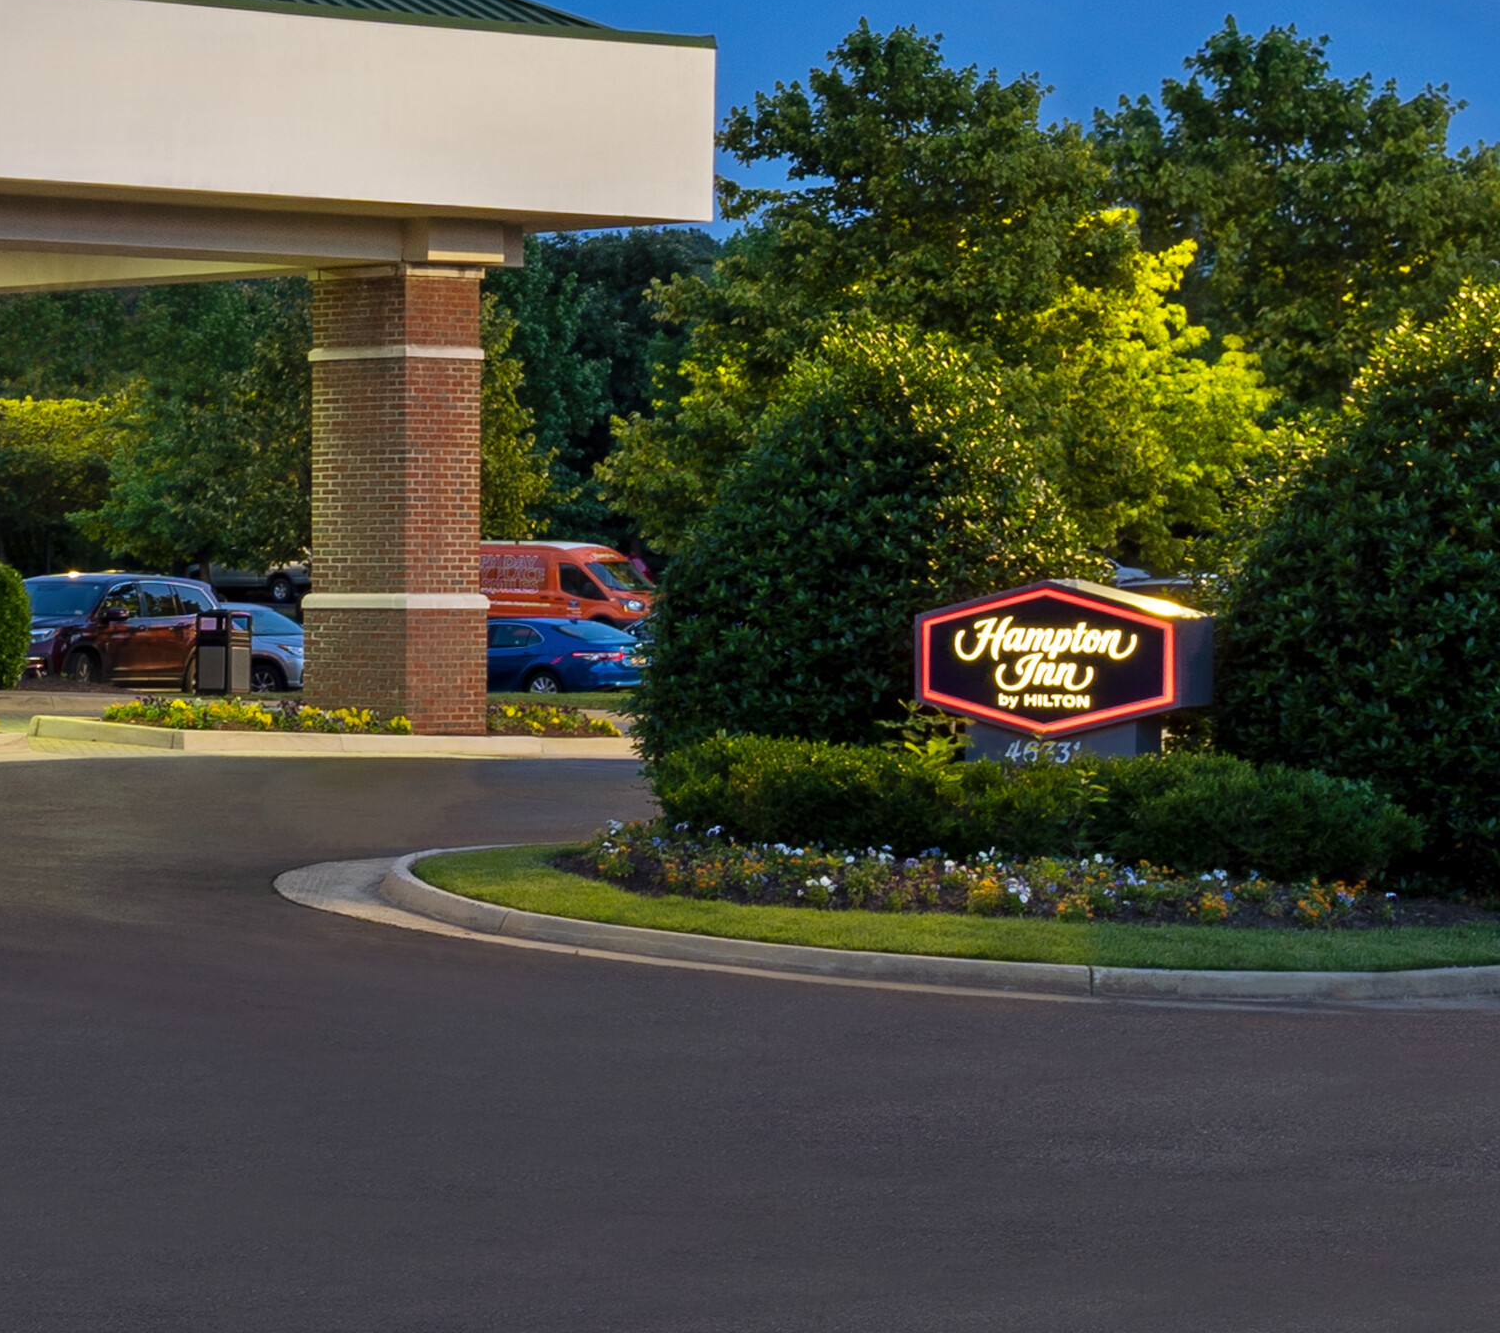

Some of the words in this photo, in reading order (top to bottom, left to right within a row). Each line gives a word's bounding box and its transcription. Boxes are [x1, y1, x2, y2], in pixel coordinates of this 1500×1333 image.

[954, 615, 1138, 661] Hampton
[995, 652, 1094, 691] Inn
[998, 693, 1019, 709] by
[1023, 694, 1090, 708] HILTON
